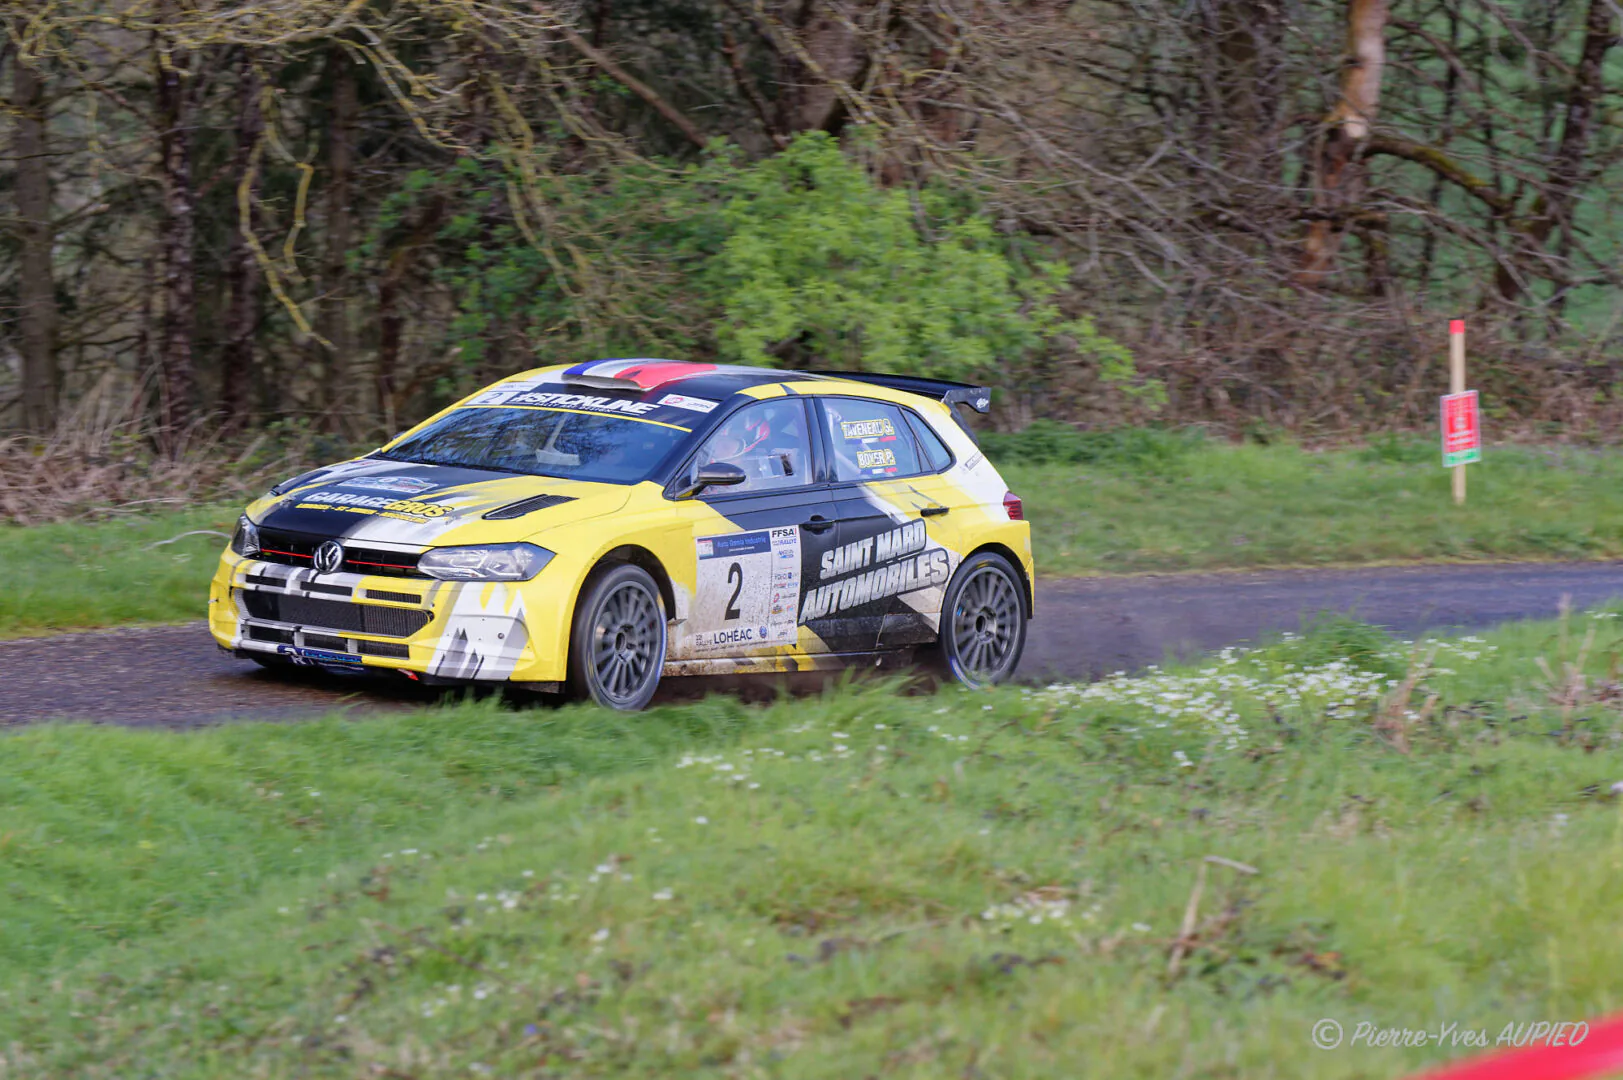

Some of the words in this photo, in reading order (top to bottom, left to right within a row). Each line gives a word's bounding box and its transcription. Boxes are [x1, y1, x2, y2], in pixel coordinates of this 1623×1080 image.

[856, 449, 885, 469] BOYER
[302, 492, 397, 507] GARAGE
[382, 499, 454, 517] GROS
[820, 537, 874, 580] SAINT
[876, 522, 925, 561] MARD
[724, 562, 743, 621] 2
[799, 552, 948, 623] AUTOMOBILES
[713, 628, 753, 645] LOHÉAC
